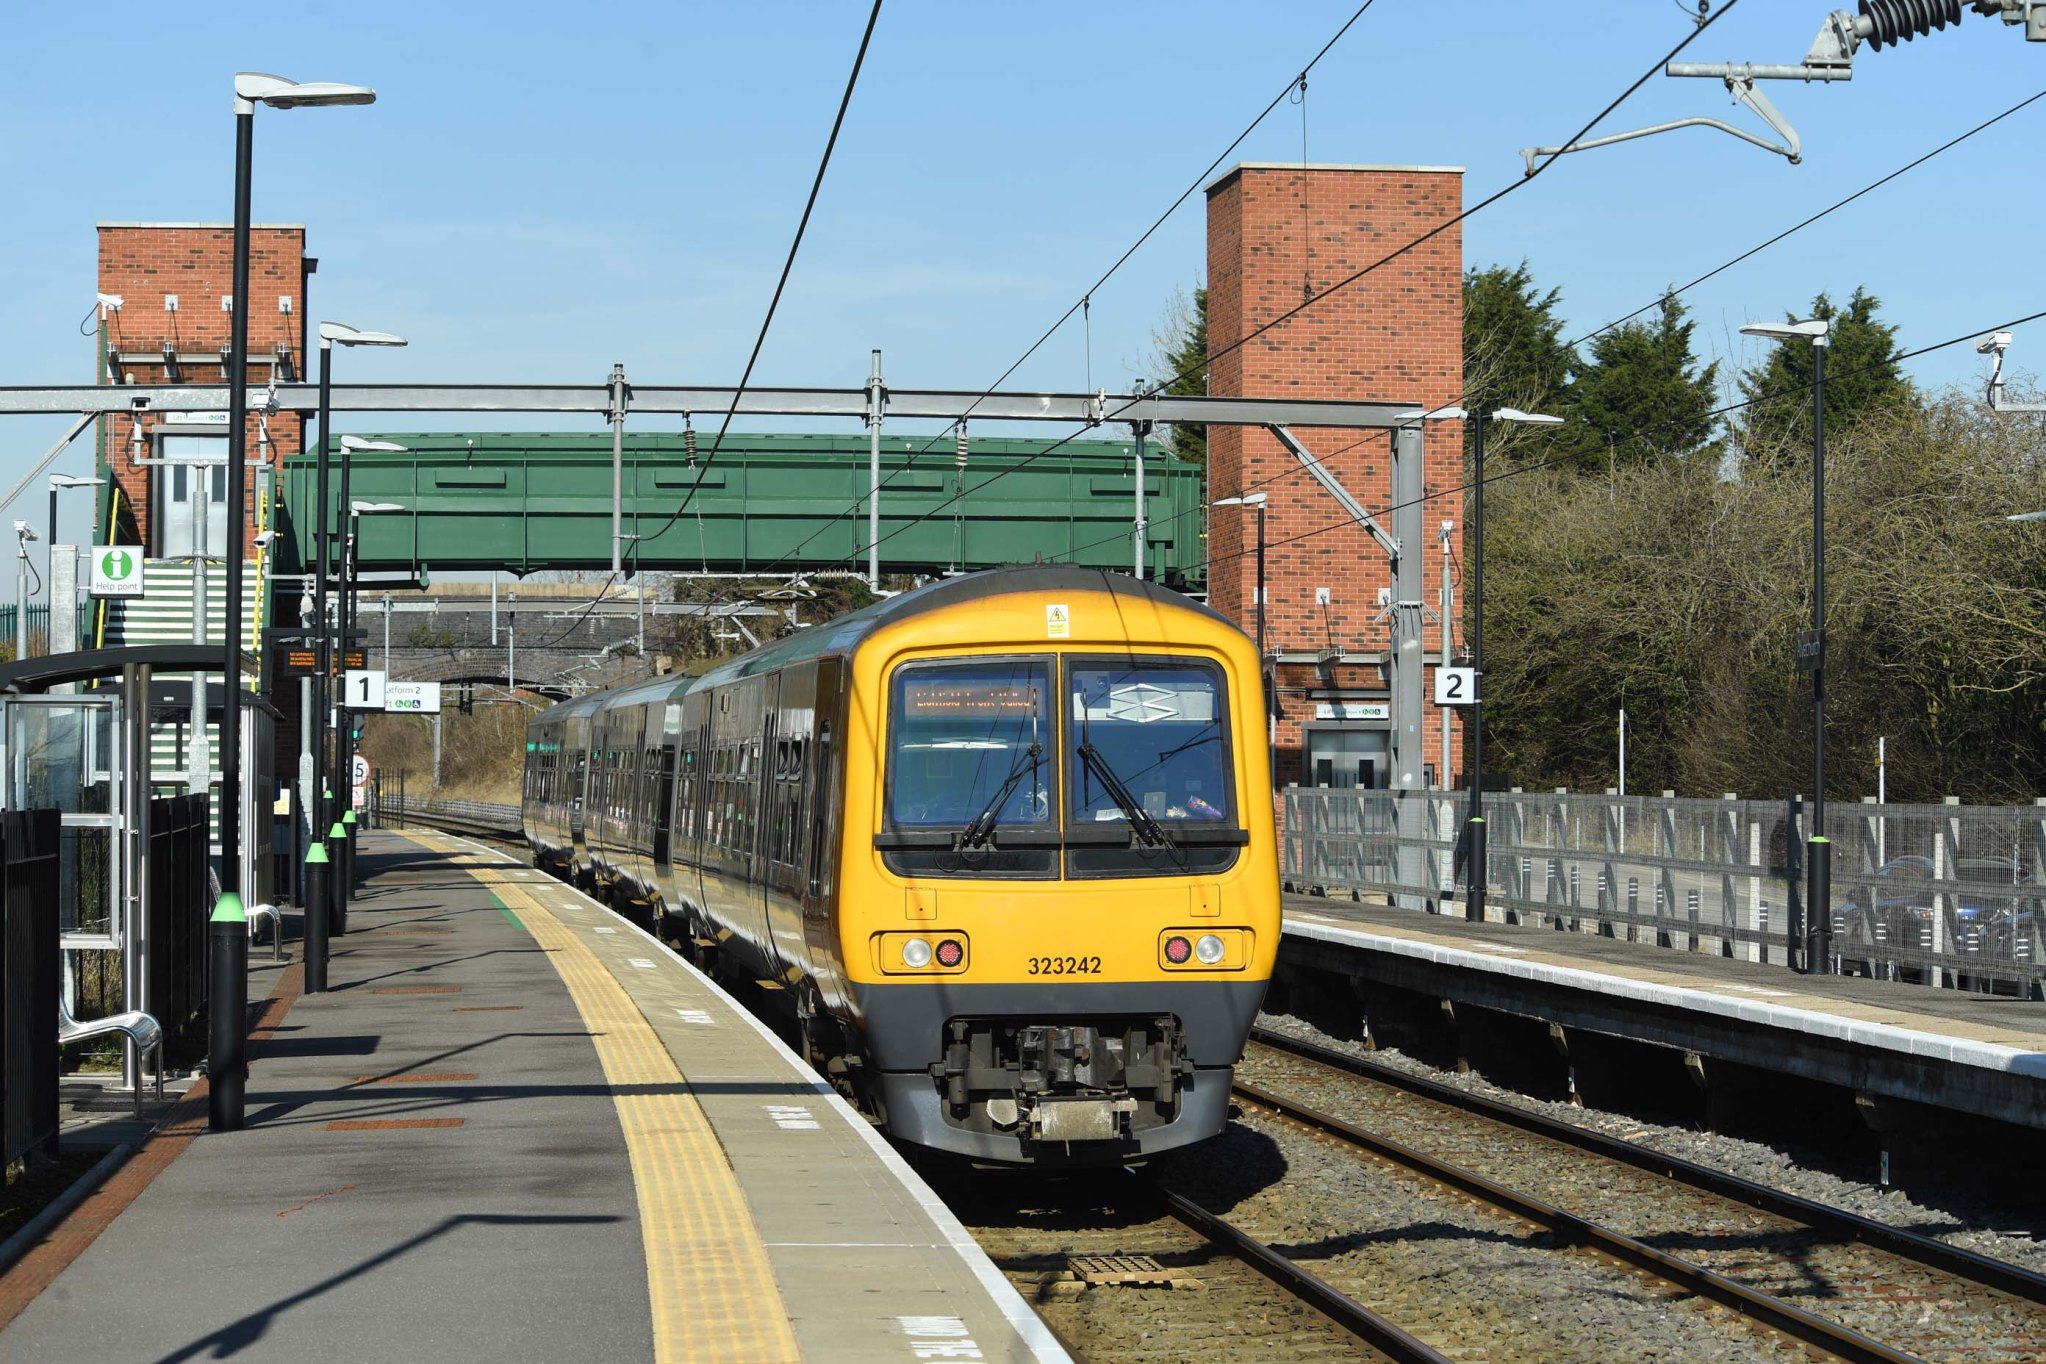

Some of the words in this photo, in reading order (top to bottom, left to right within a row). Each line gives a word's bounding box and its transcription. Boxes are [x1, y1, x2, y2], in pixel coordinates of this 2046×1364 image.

[96, 582, 115, 592] Help
[118, 583, 138, 592] point
[358, 676, 369, 702] 1
[385, 686, 413, 694] atform
[415, 686, 421, 694] 2
[1446, 673, 1462, 698] 2
[1028, 956, 1102, 975] 323242
